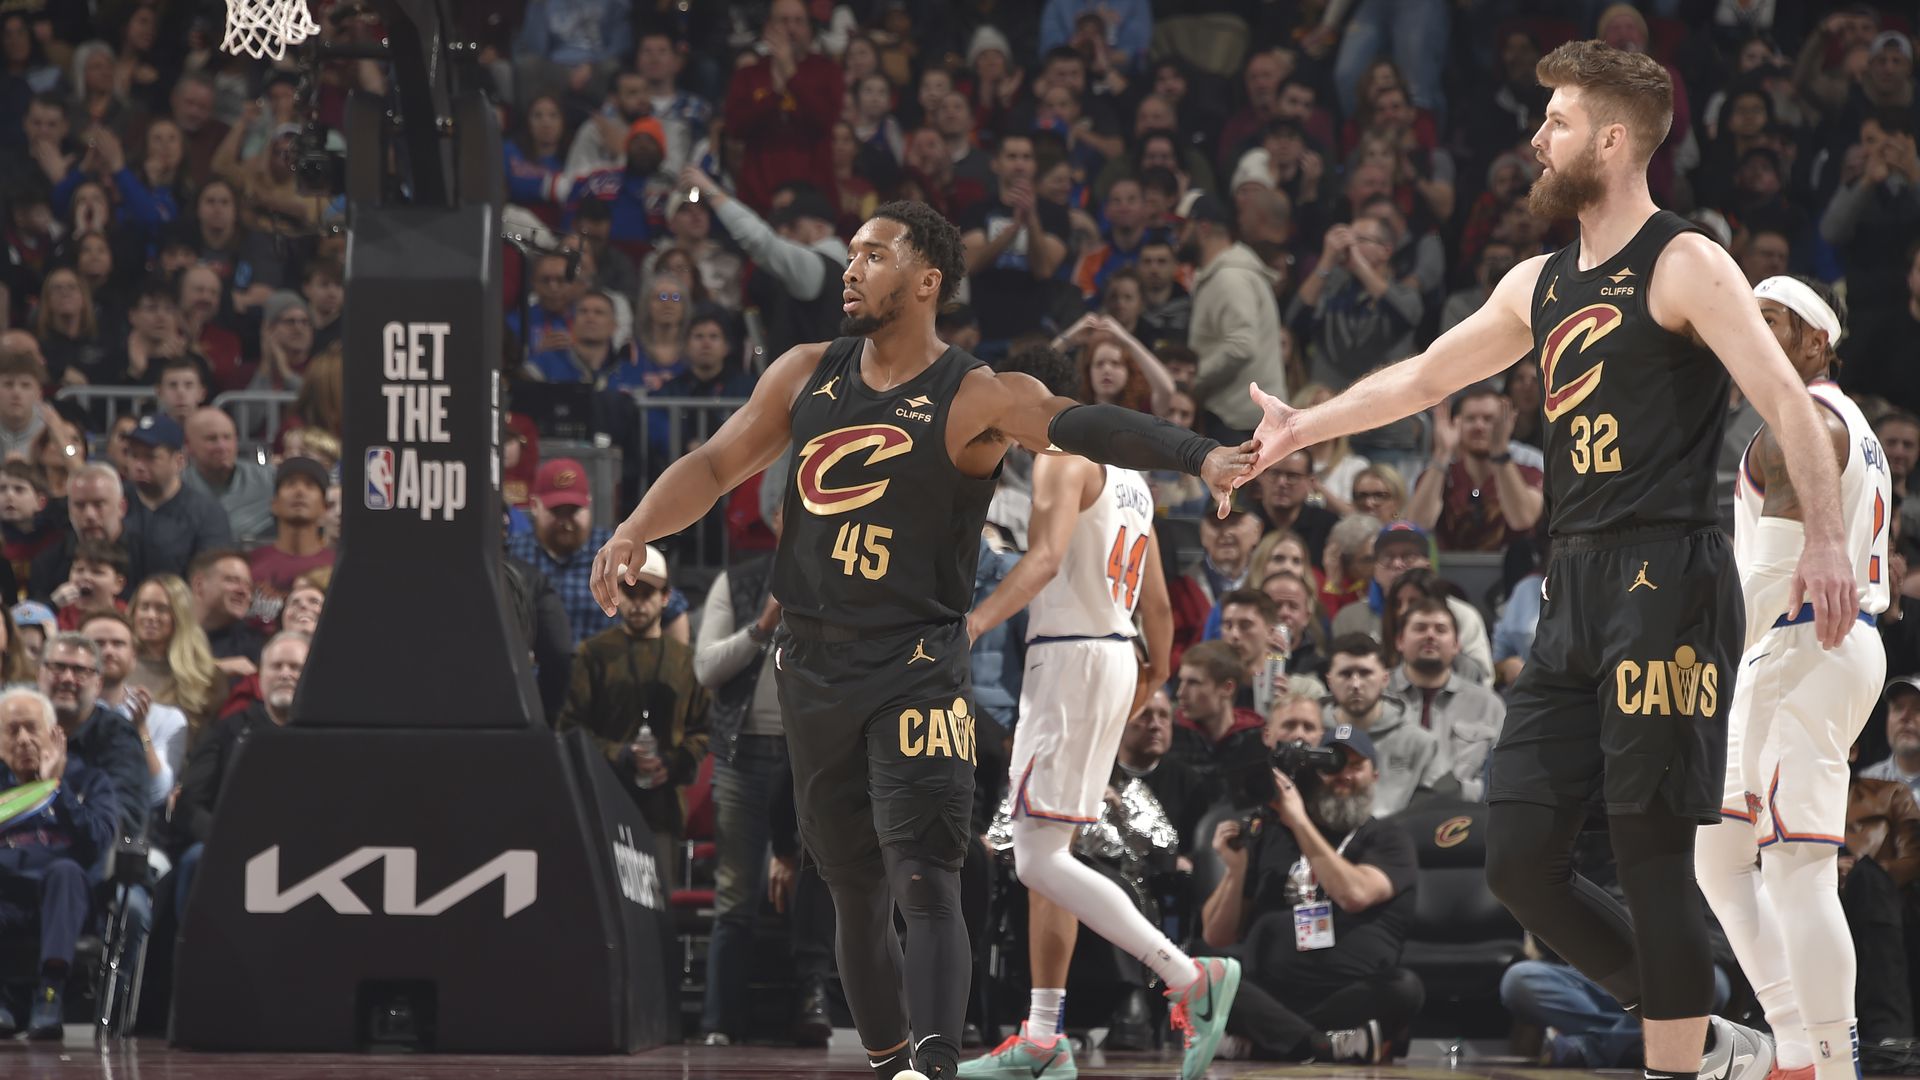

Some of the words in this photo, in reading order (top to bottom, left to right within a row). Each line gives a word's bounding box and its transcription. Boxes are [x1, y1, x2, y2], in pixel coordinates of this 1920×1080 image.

[1601, 285, 1635, 297] CLIFFS
[382, 320, 451, 381] GET
[381, 384, 452, 443] THE
[895, 407, 933, 423] CLIFFS
[1570, 413, 1623, 474] 32
[396, 447, 467, 521] App
[831, 520, 894, 581] 45
[1107, 525, 1149, 612] 44
[1616, 645, 1719, 718] CAVS
